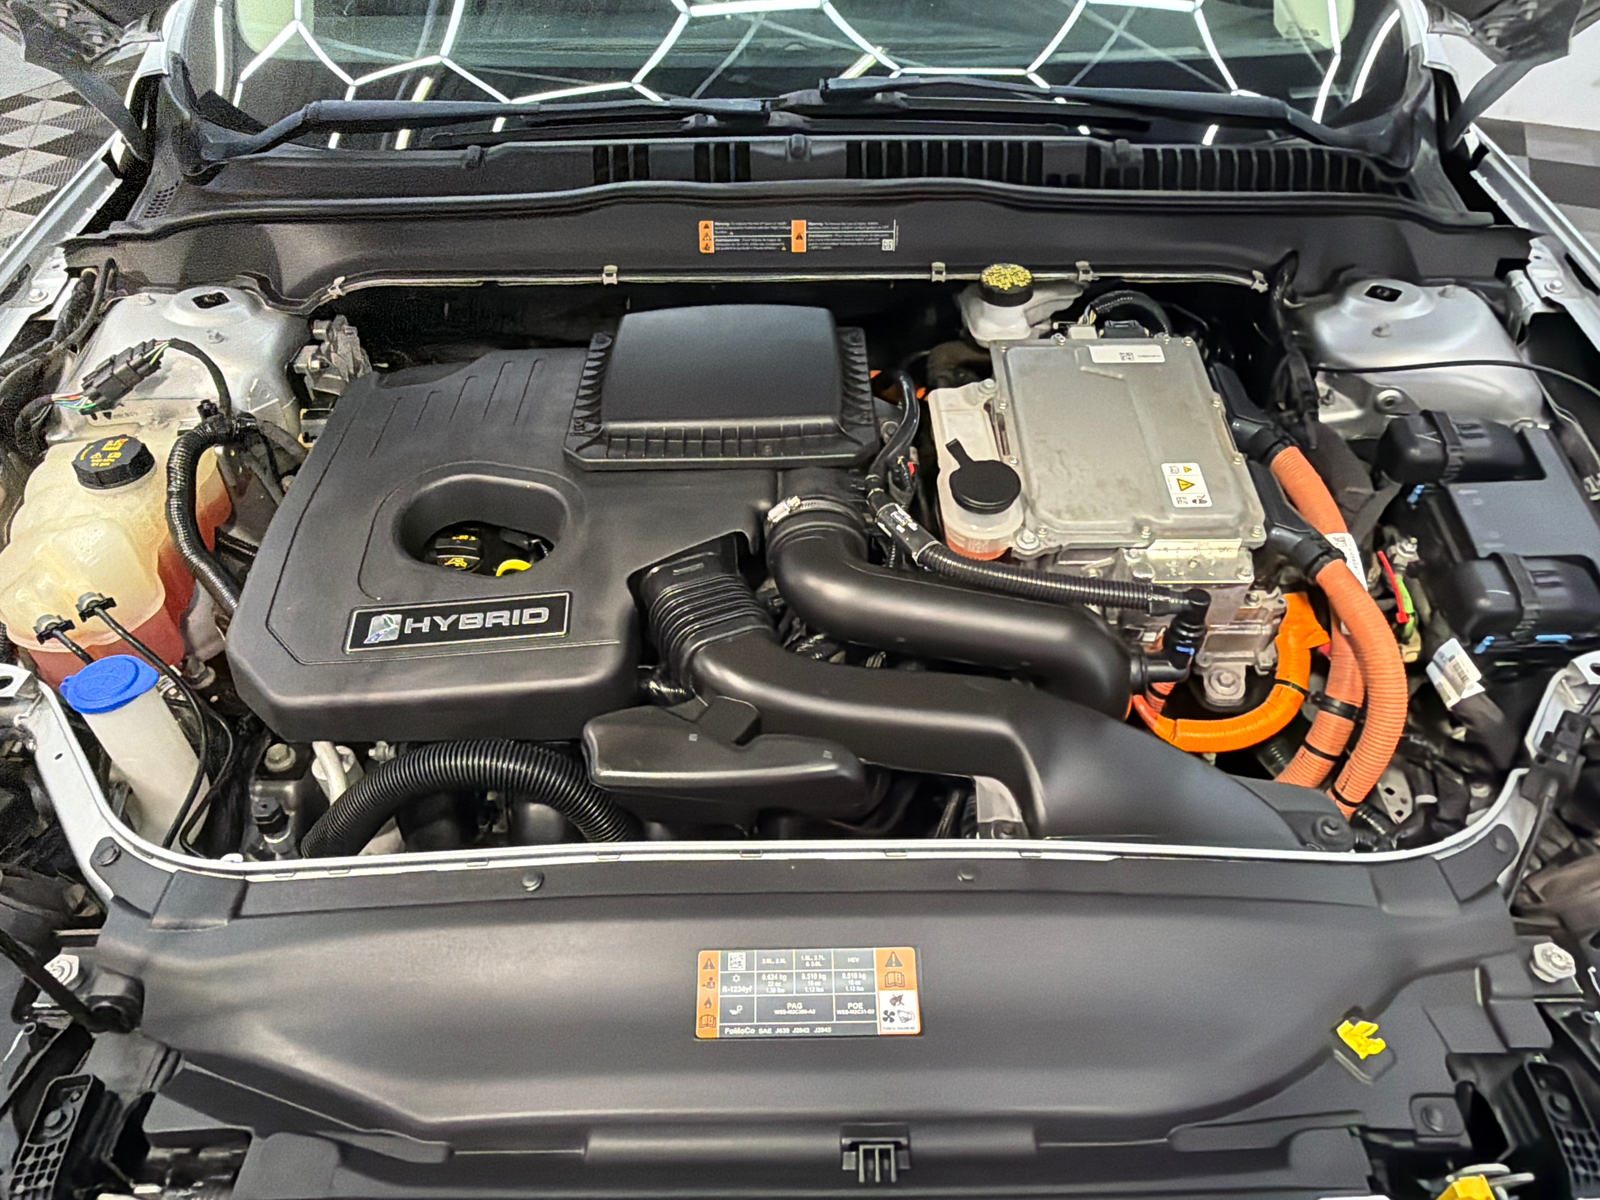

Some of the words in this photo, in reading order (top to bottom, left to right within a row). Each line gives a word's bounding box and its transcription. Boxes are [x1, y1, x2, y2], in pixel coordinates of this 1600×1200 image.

[404, 606, 550, 635] HYBRID
[779, 973, 788, 982] kg
[818, 972, 827, 982] kg
[858, 972, 867, 981] kg
[722, 986, 753, 994] R-1234yf
[786, 1002, 803, 1010] PAG
[724, 1026, 756, 1035] FoMoCo
